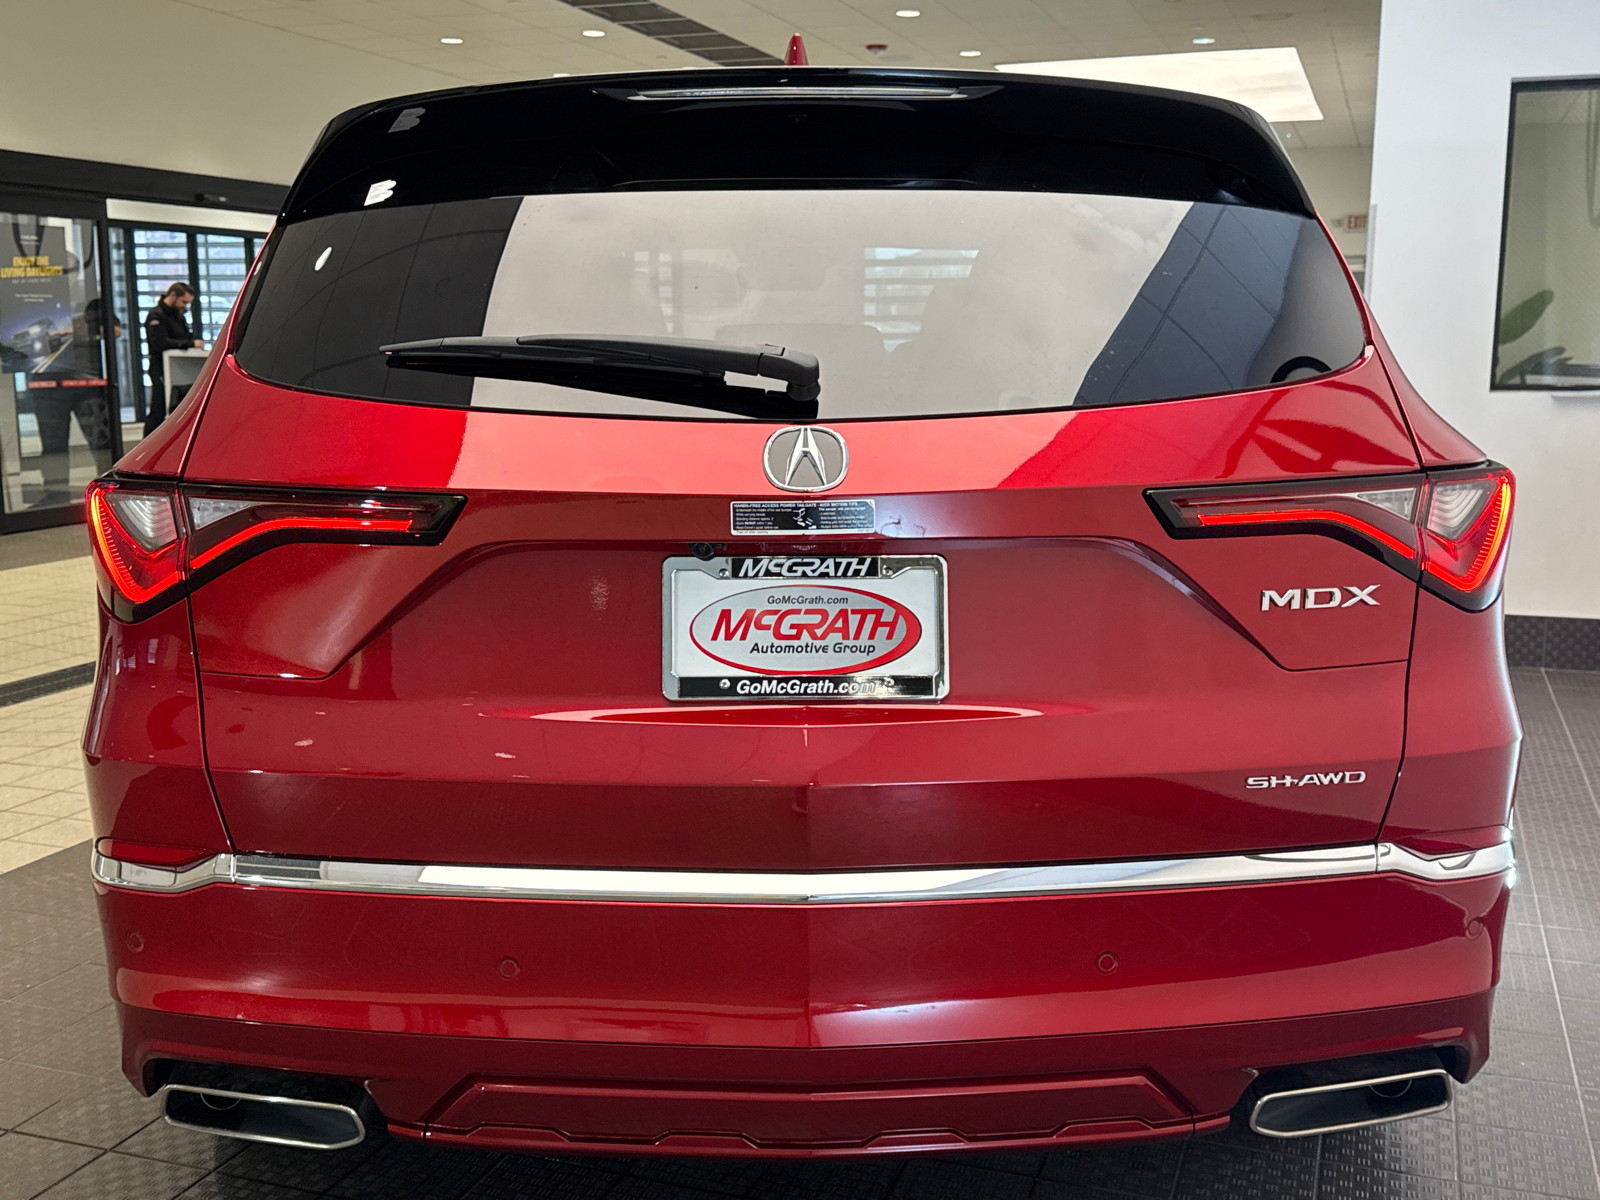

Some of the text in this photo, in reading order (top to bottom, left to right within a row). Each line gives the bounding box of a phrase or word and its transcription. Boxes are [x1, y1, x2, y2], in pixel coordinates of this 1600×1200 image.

[739, 558, 871, 577] McGRATH
[767, 595, 849, 605] GoMcGrath.com
[1261, 584, 1380, 611] MDX
[710, 608, 900, 641] McGRATH
[750, 642, 876, 656] Automotive Group
[736, 679, 876, 695] GoMcGrath.com
[1246, 771, 1366, 789] SH-AWD
